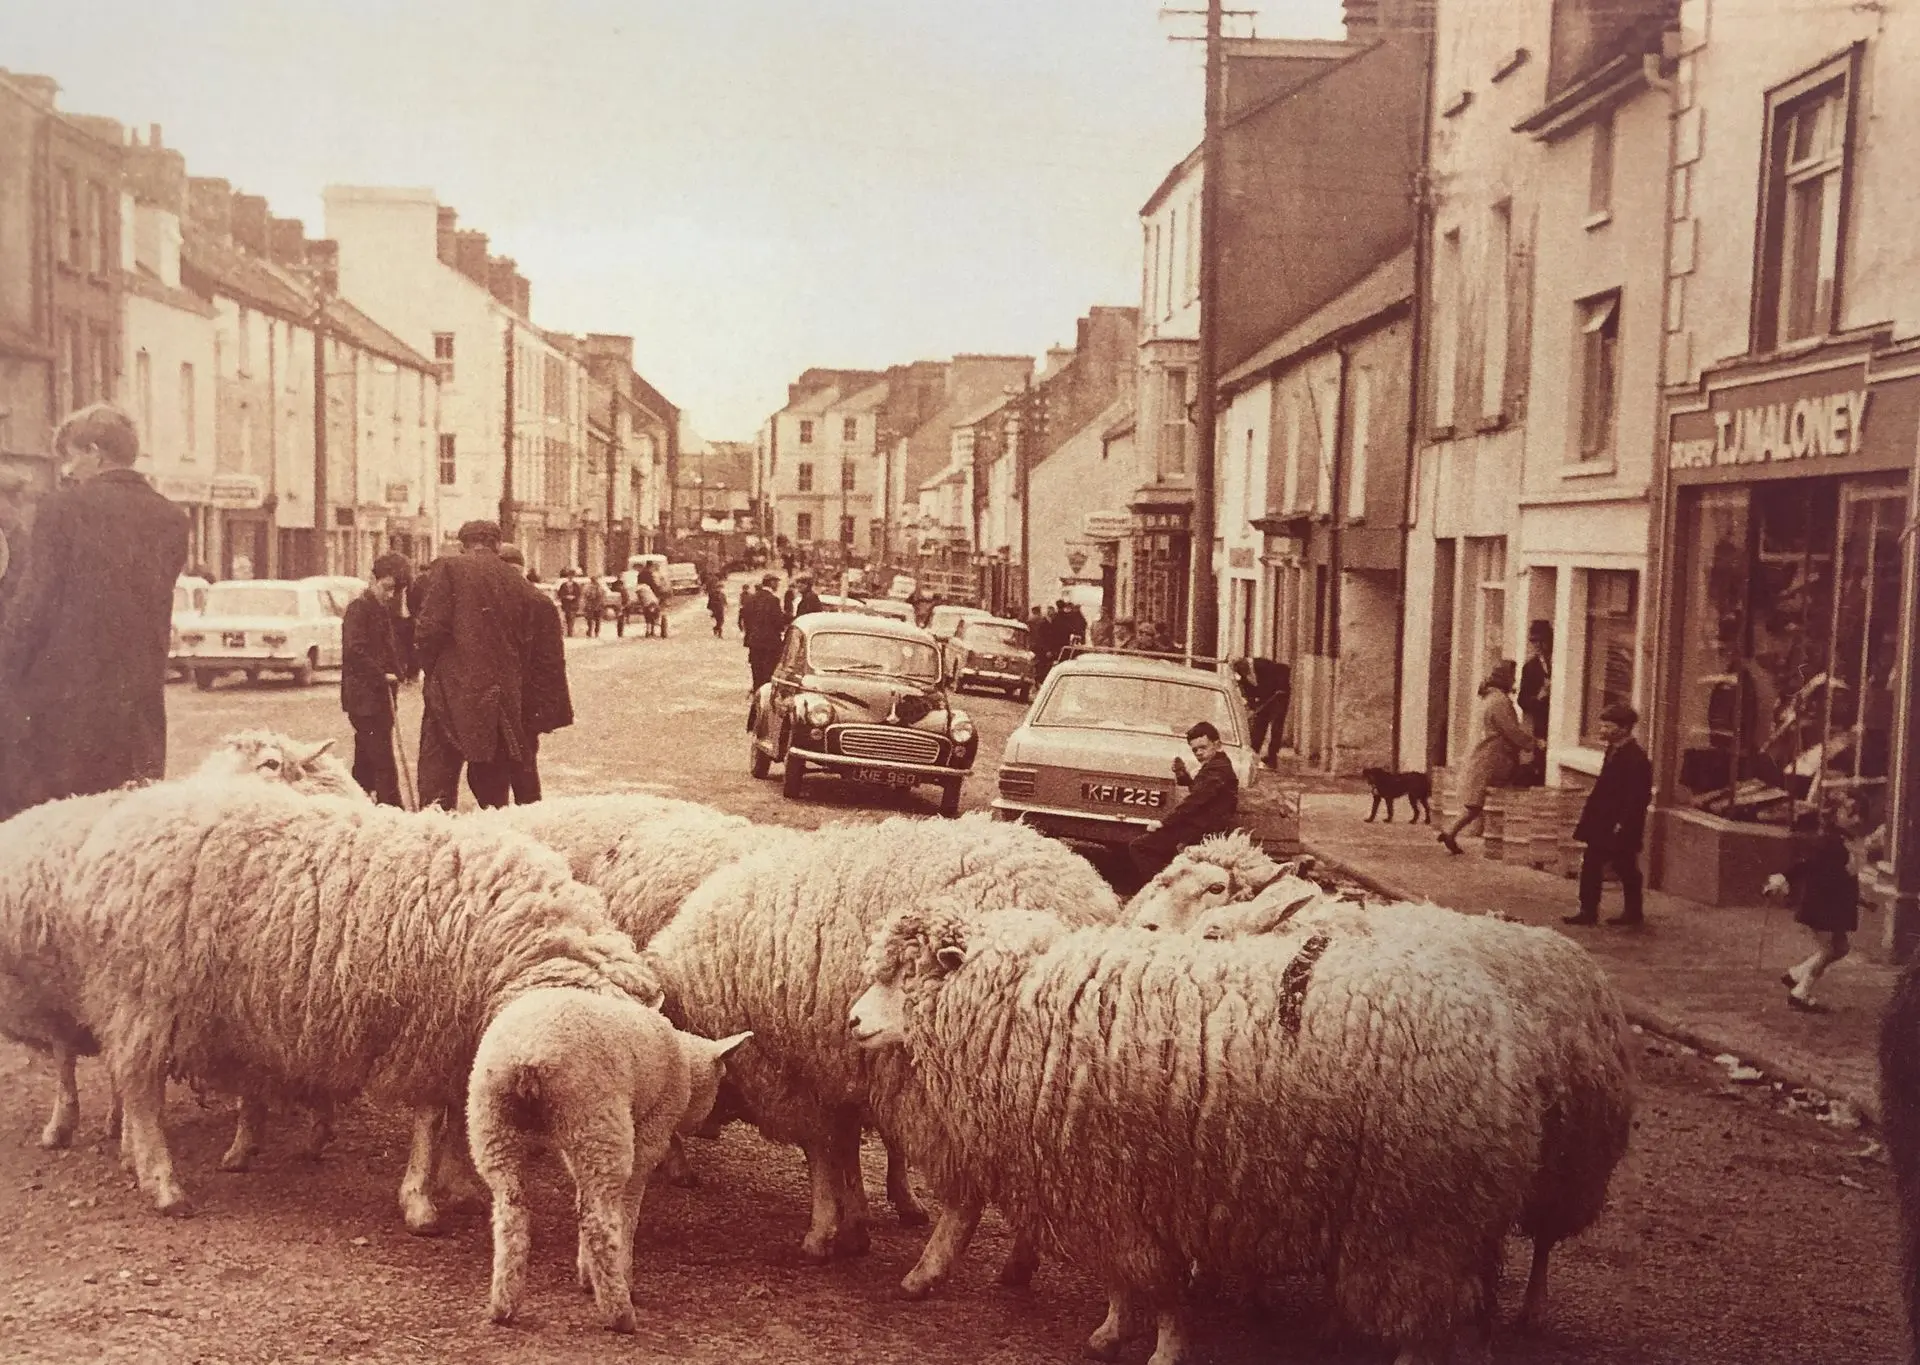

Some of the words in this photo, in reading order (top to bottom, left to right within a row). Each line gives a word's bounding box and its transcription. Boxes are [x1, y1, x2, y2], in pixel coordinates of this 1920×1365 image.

[1146, 514, 1180, 527] BAR
[1088, 783, 1119, 802] KFI
[1122, 788, 1161, 807] 225
